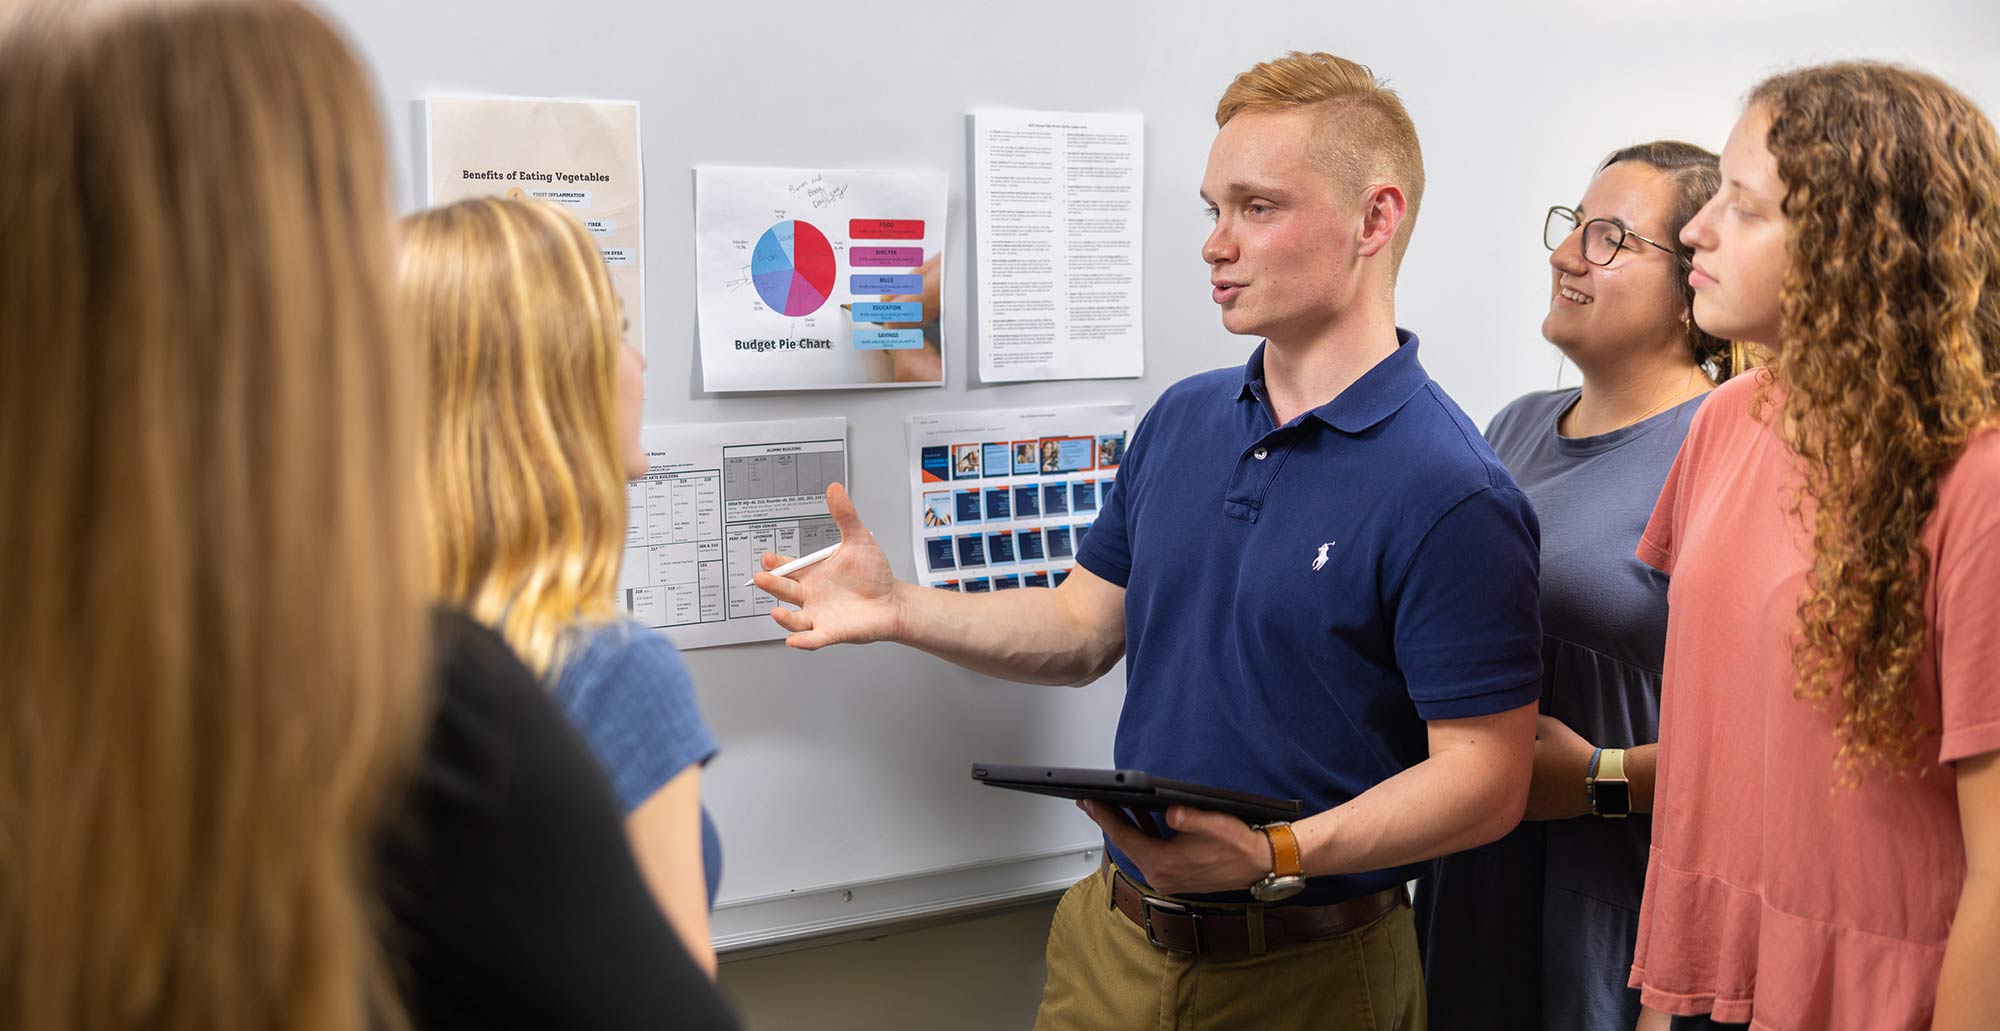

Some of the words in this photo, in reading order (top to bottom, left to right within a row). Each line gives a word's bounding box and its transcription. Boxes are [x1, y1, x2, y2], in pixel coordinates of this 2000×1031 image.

[463, 170, 504, 180] Benefits
[506, 171, 517, 180] of
[519, 171, 553, 183] Eating
[555, 172, 610, 183] Vegetables
[735, 339, 776, 352] Budget
[779, 338, 796, 349] Pie
[799, 338, 831, 349] Chart
